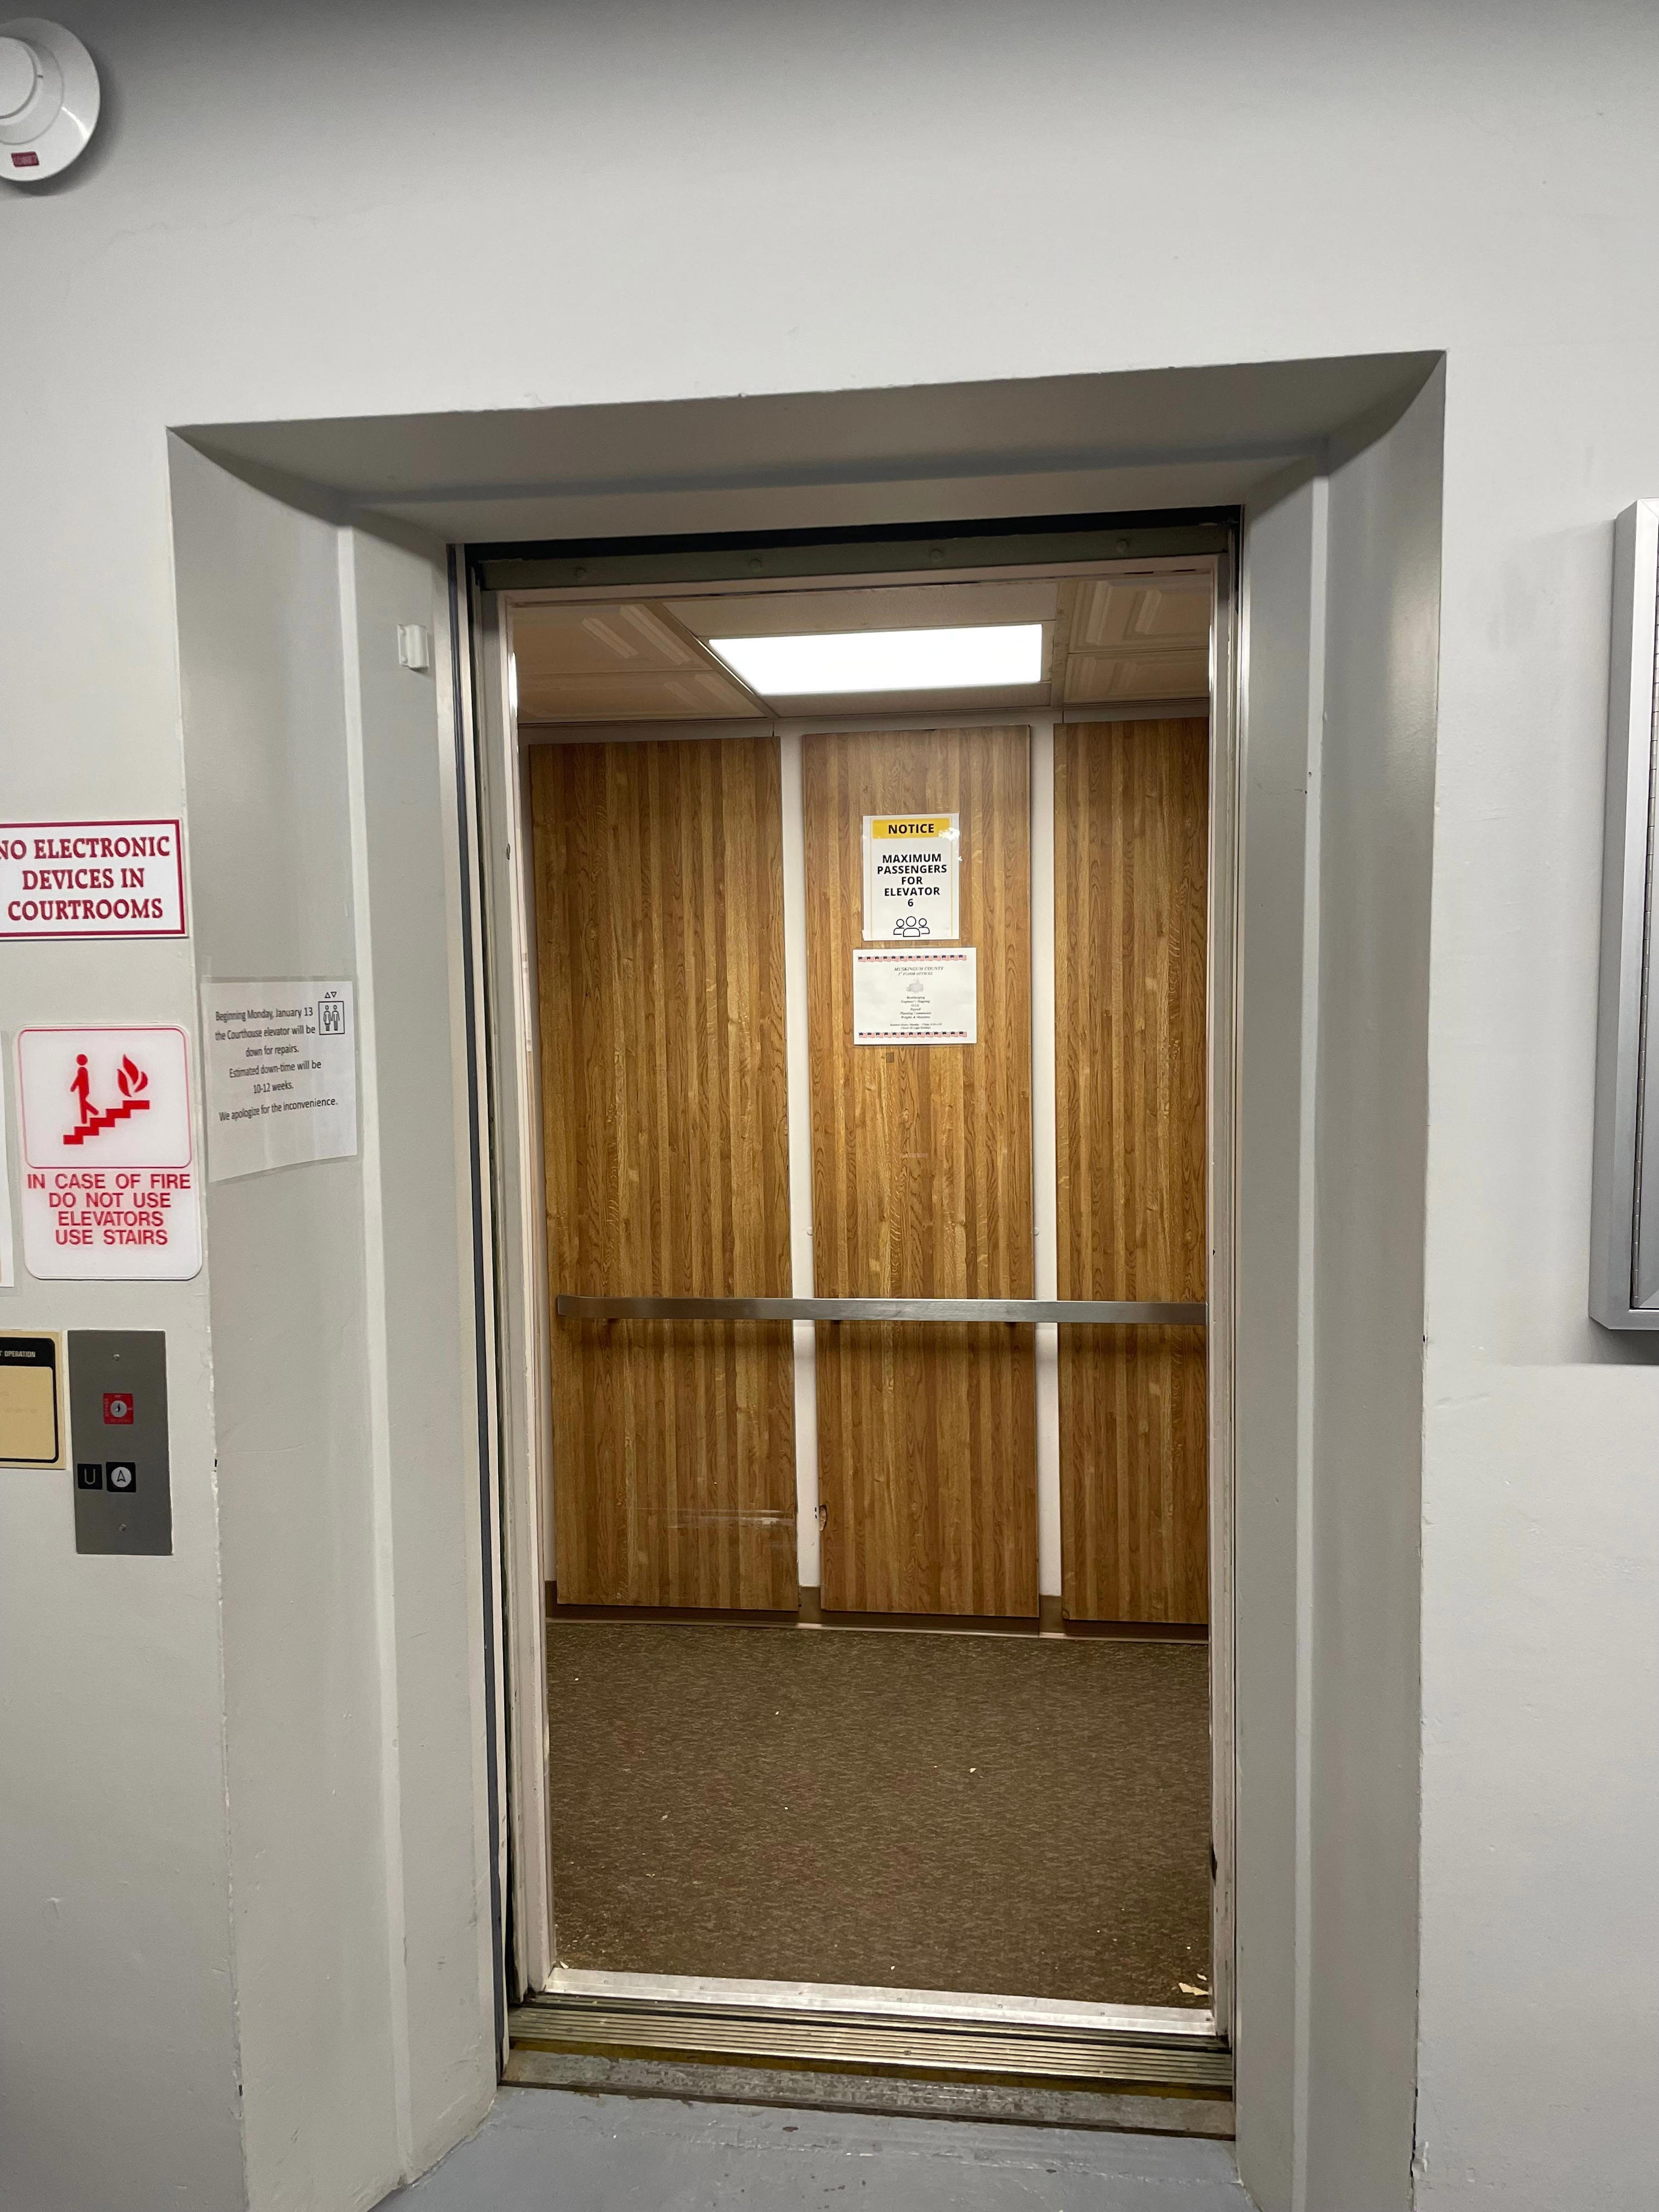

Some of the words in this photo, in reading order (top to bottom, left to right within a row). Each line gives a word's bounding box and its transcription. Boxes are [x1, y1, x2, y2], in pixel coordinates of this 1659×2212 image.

[888, 824, 934, 834] NOTICE
[0, 840, 27, 859] NO
[34, 836, 170, 859] ELECTRONIC
[882, 853, 942, 863] MAXIMUM
[877, 864, 947, 875] PASSENGERS
[22, 868, 114, 890] DEVICES
[120, 868, 144, 888] IN
[901, 876, 923, 885] FOR
[884, 887, 941, 896] ELEVATOR
[8, 898, 163, 921] COURTROOMS
[908, 899, 914, 907] 6
[215, 1010, 247, 1023] Beginning
[247, 1009, 274, 1020] Monday,
[276, 1008, 302, 1018] January
[304, 1007, 313, 1016] 13
[215, 1031, 225, 1040] the
[227, 1028, 262, 1040] Courthouse
[264, 1027, 290, 1037] elevator
[291, 1025, 304, 1035] will
[306, 1025, 316, 1034] be
[245, 1047, 263, 1057] down
[263, 1045, 273, 1055] for
[274, 1044, 299, 1056] repairs.
[229, 1065, 259, 1078] Estimated
[261, 1063, 295, 1074] down-time
[297, 1060, 310, 1070] will
[311, 1060, 321, 1069] be
[253, 1083, 270, 1094] 10-12
[272, 1080, 294, 1091] weeks.
[219, 1112, 230, 1121] We
[231, 1107, 259, 1121] apologize
[261, 1104, 270, 1114] for
[271, 1103, 282, 1113] the
[283, 1098, 338, 1112] inconvenience.
[27, 1173, 45, 1189] IN
[55, 1173, 105, 1189] CASE
[115, 1173, 141, 1189] OF
[151, 1173, 191, 1189] FIRE
[49, 1192, 76, 1208] DO
[86, 1192, 124, 1208] NOT
[133, 1192, 171, 1208] USE
[58, 1211, 164, 1226] ELEVATORS
[56, 1229, 93, 1245] USE
[103, 1229, 168, 1245] STAIRS
